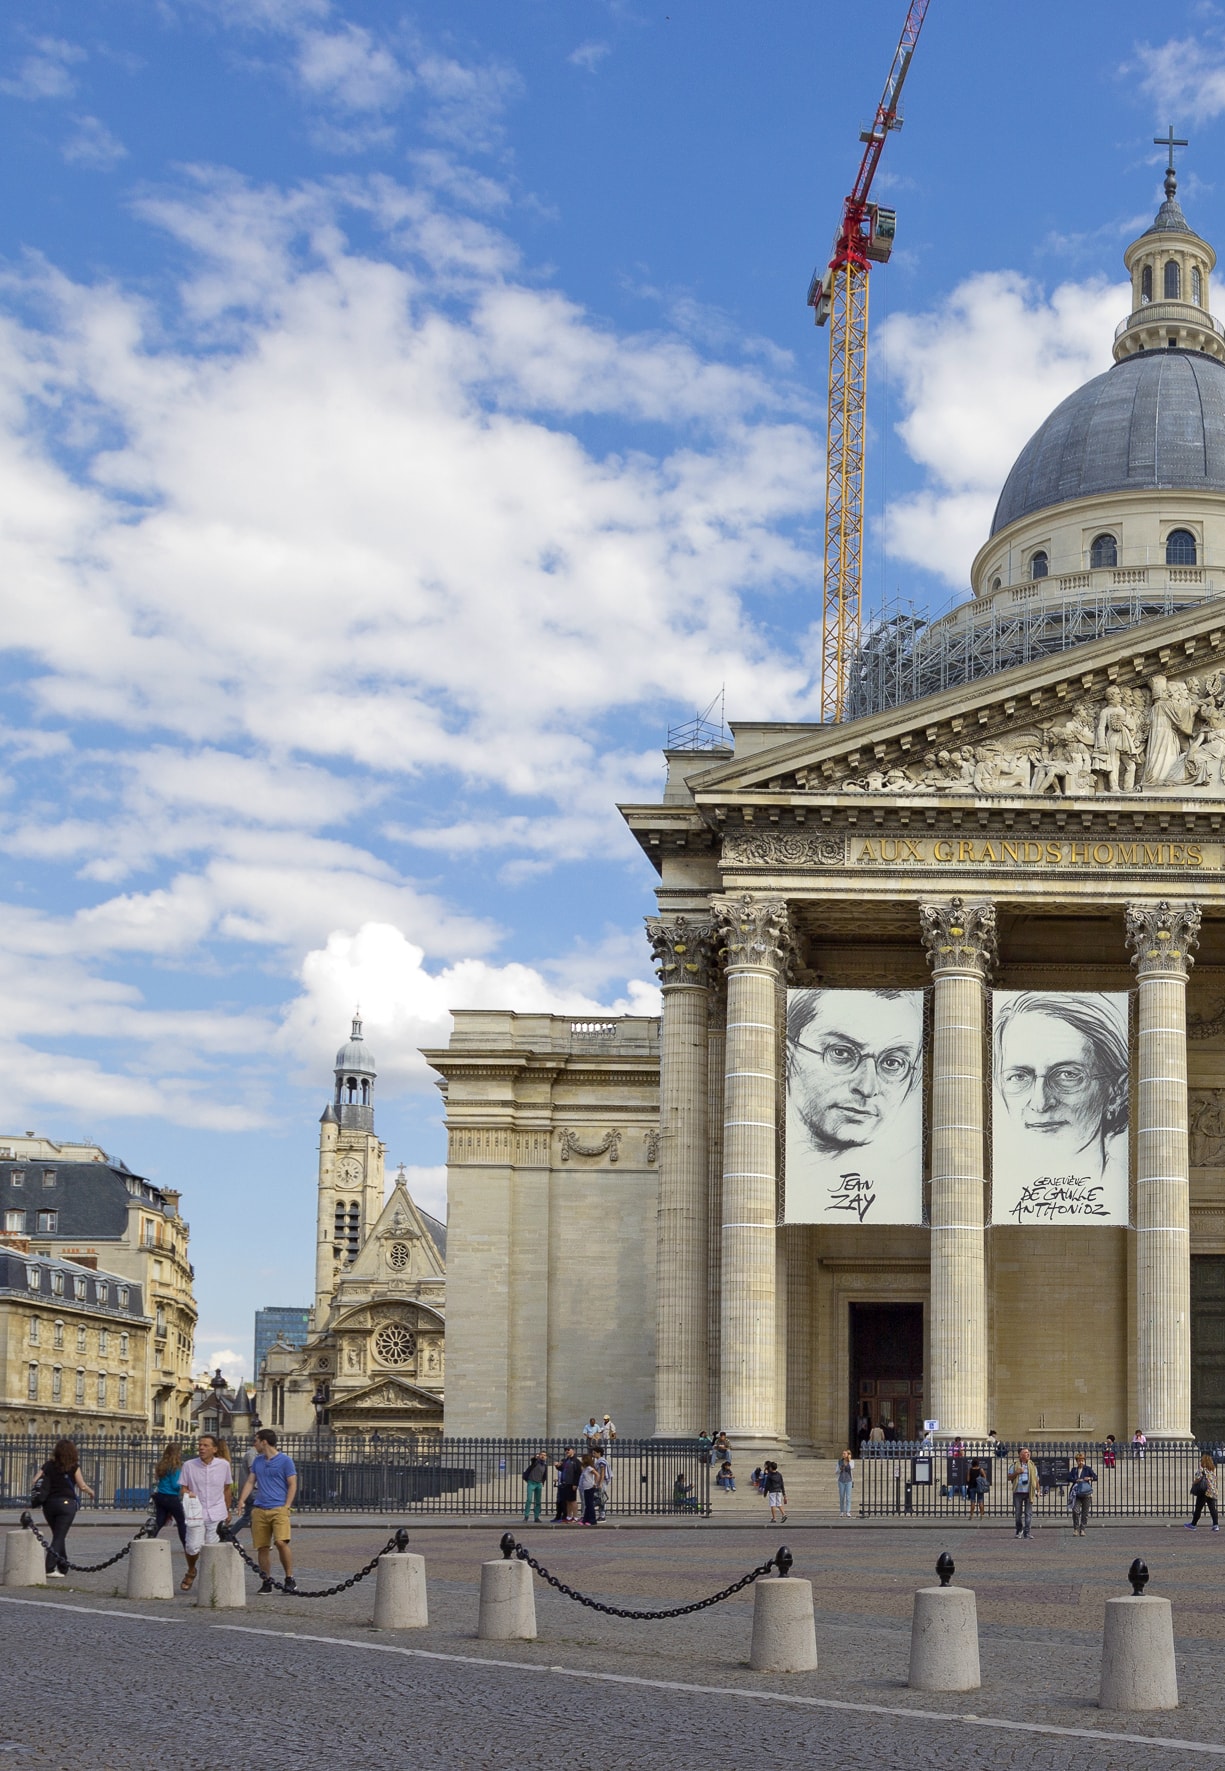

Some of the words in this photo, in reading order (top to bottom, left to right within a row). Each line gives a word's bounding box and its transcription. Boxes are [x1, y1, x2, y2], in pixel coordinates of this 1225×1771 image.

[857, 838, 925, 861] AUX
[932, 839, 1064, 863] GRANDS
[1069, 842, 1204, 866] HOMMES
[828, 1173, 874, 1192] JEAN
[1020, 1186, 1046, 1203] DE
[1043, 1186, 1104, 1202] GAULLE
[824, 1193, 876, 1222] ZAY
